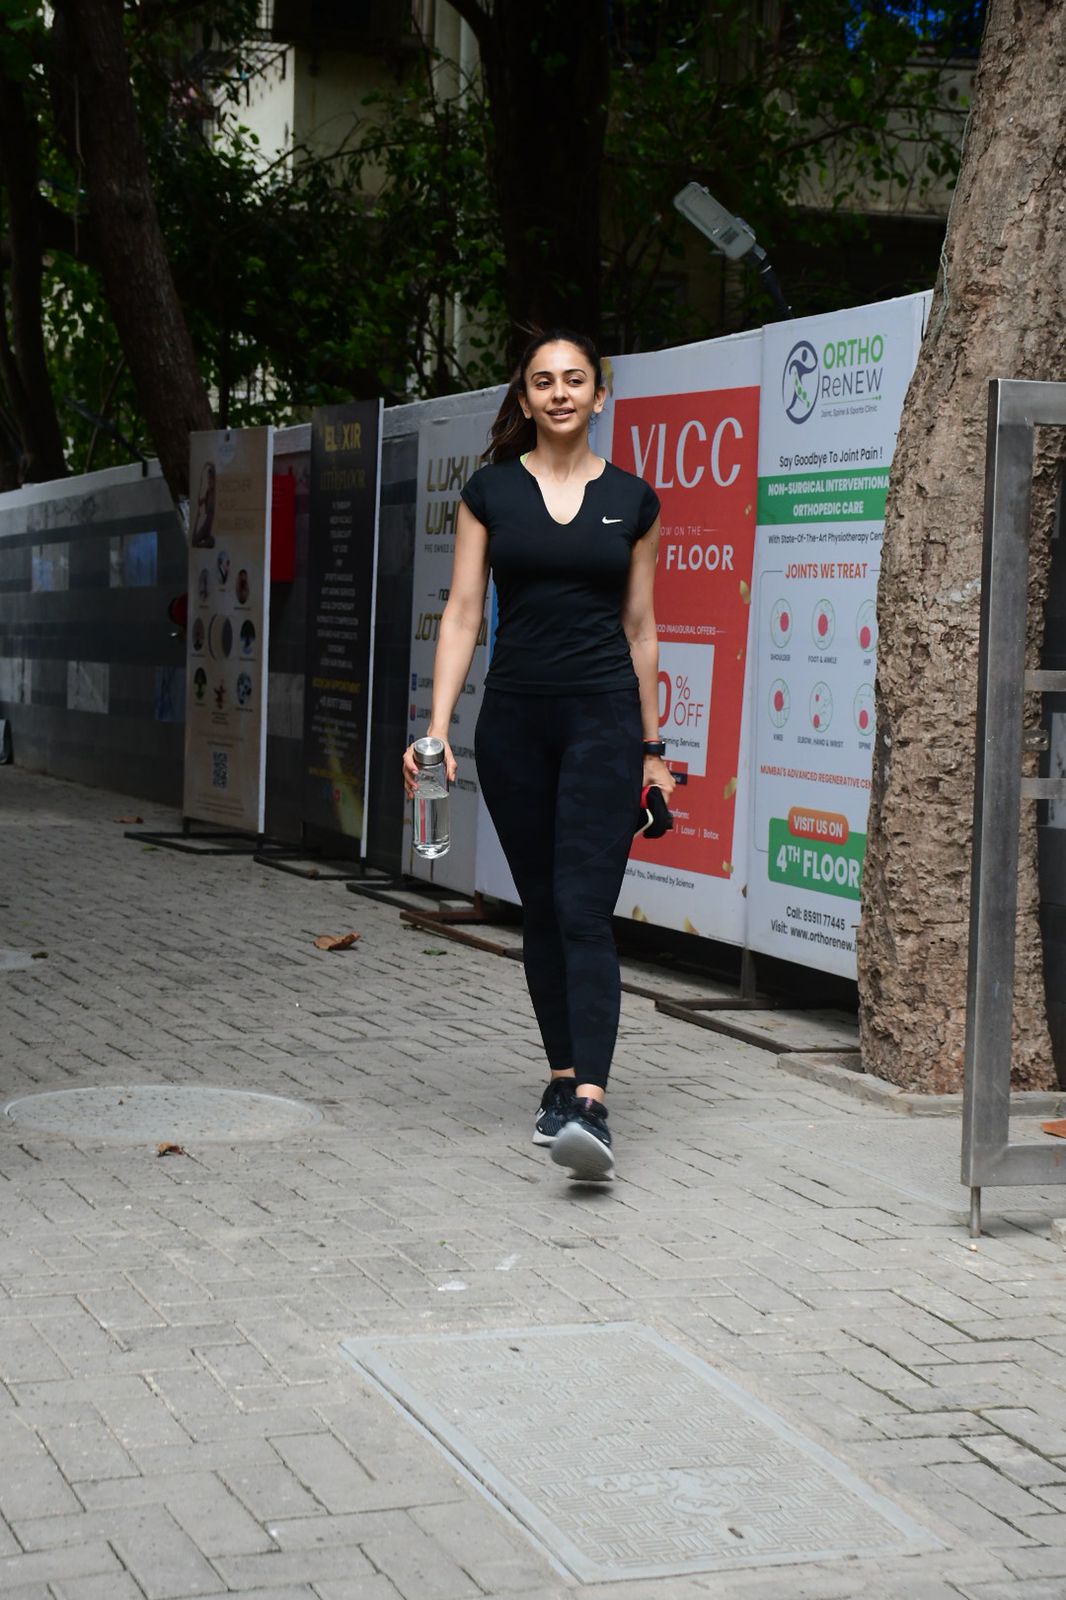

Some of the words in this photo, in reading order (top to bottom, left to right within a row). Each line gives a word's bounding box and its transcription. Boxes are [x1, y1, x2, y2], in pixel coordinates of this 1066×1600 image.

[823, 334, 884, 369] ORTHO
[821, 367, 884, 399] ReNEW
[631, 417, 743, 489] VLCC
[779, 455, 793, 471] Say
[794, 452, 827, 468] Goodbye
[828, 451, 838, 464] To
[839, 448, 859, 463] Joint
[860, 446, 878, 460] Pain
[768, 480, 825, 496] NON-SURGICAL
[826, 475, 889, 492] INTERVENTIONA
[793, 502, 841, 517] ORTHOPEDIC
[842, 500, 864, 514] CARE
[660, 526, 672, 537] OW
[674, 526, 685, 537] ON
[688, 525, 702, 537] THE
[768, 533, 780, 544] With
[828, 531, 869, 545] Physiotherapy
[665, 543, 734, 571] FLOOR
[785, 563, 818, 579] JOINTS
[820, 563, 835, 579] WE
[838, 562, 868, 579] TREAT
[674, 702, 704, 728] OFF
[680, 734, 700, 748] Services
[787, 768, 817, 783] ADVANCED
[818, 773, 860, 789] REGENERATIVE
[703, 828, 719, 841] Botox
[793, 815, 815, 833] VISIT
[815, 819, 828, 834] US
[828, 822, 843, 838] ON
[776, 844, 800, 873] 4TH
[802, 848, 861, 889] FLOOR
[646, 871, 668, 885] Delivered
[669, 876, 676, 888] by
[675, 877, 695, 890] Science
[770, 918, 788, 936] Visit:
[786, 905, 802, 920] Call:
[803, 908, 822, 926] 85911
[823, 914, 846, 931] 77445
